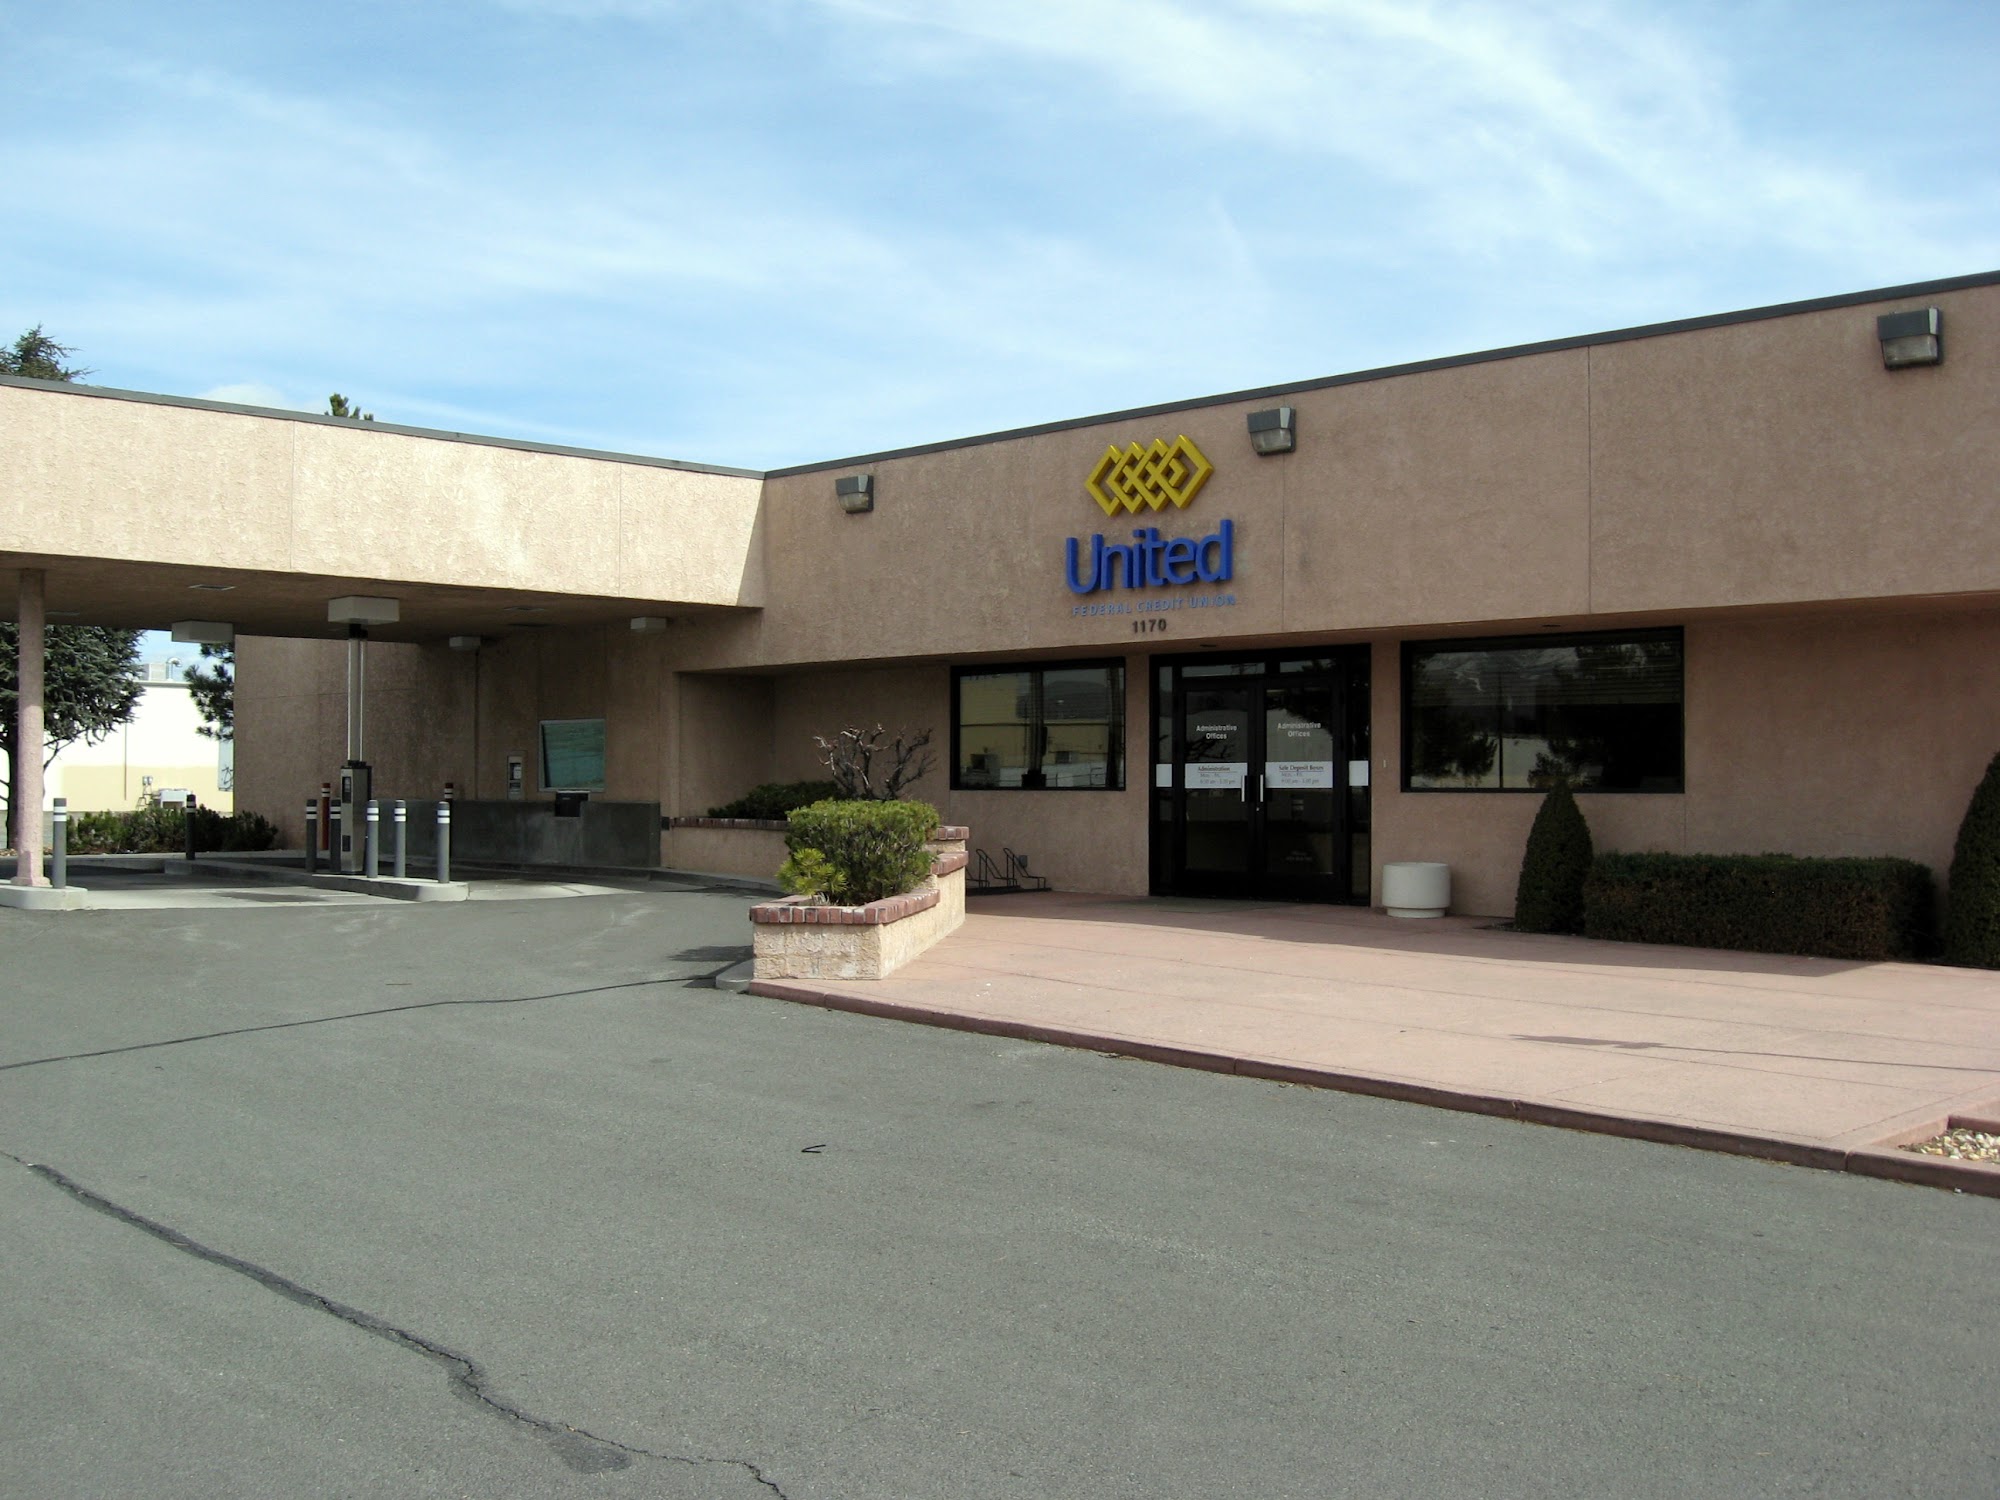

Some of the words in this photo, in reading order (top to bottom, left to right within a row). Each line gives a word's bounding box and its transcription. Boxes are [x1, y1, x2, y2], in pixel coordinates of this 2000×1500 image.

[1065, 519, 1233, 594] United
[1072, 603, 1132, 617] FEDERAL
[1136, 598, 1184, 613] CREDIT
[1189, 594, 1237, 609] UNION
[1131, 618, 1168, 634] 1170
[1196, 724, 1238, 732] Administrative
[1277, 722, 1321, 730] Administrative
